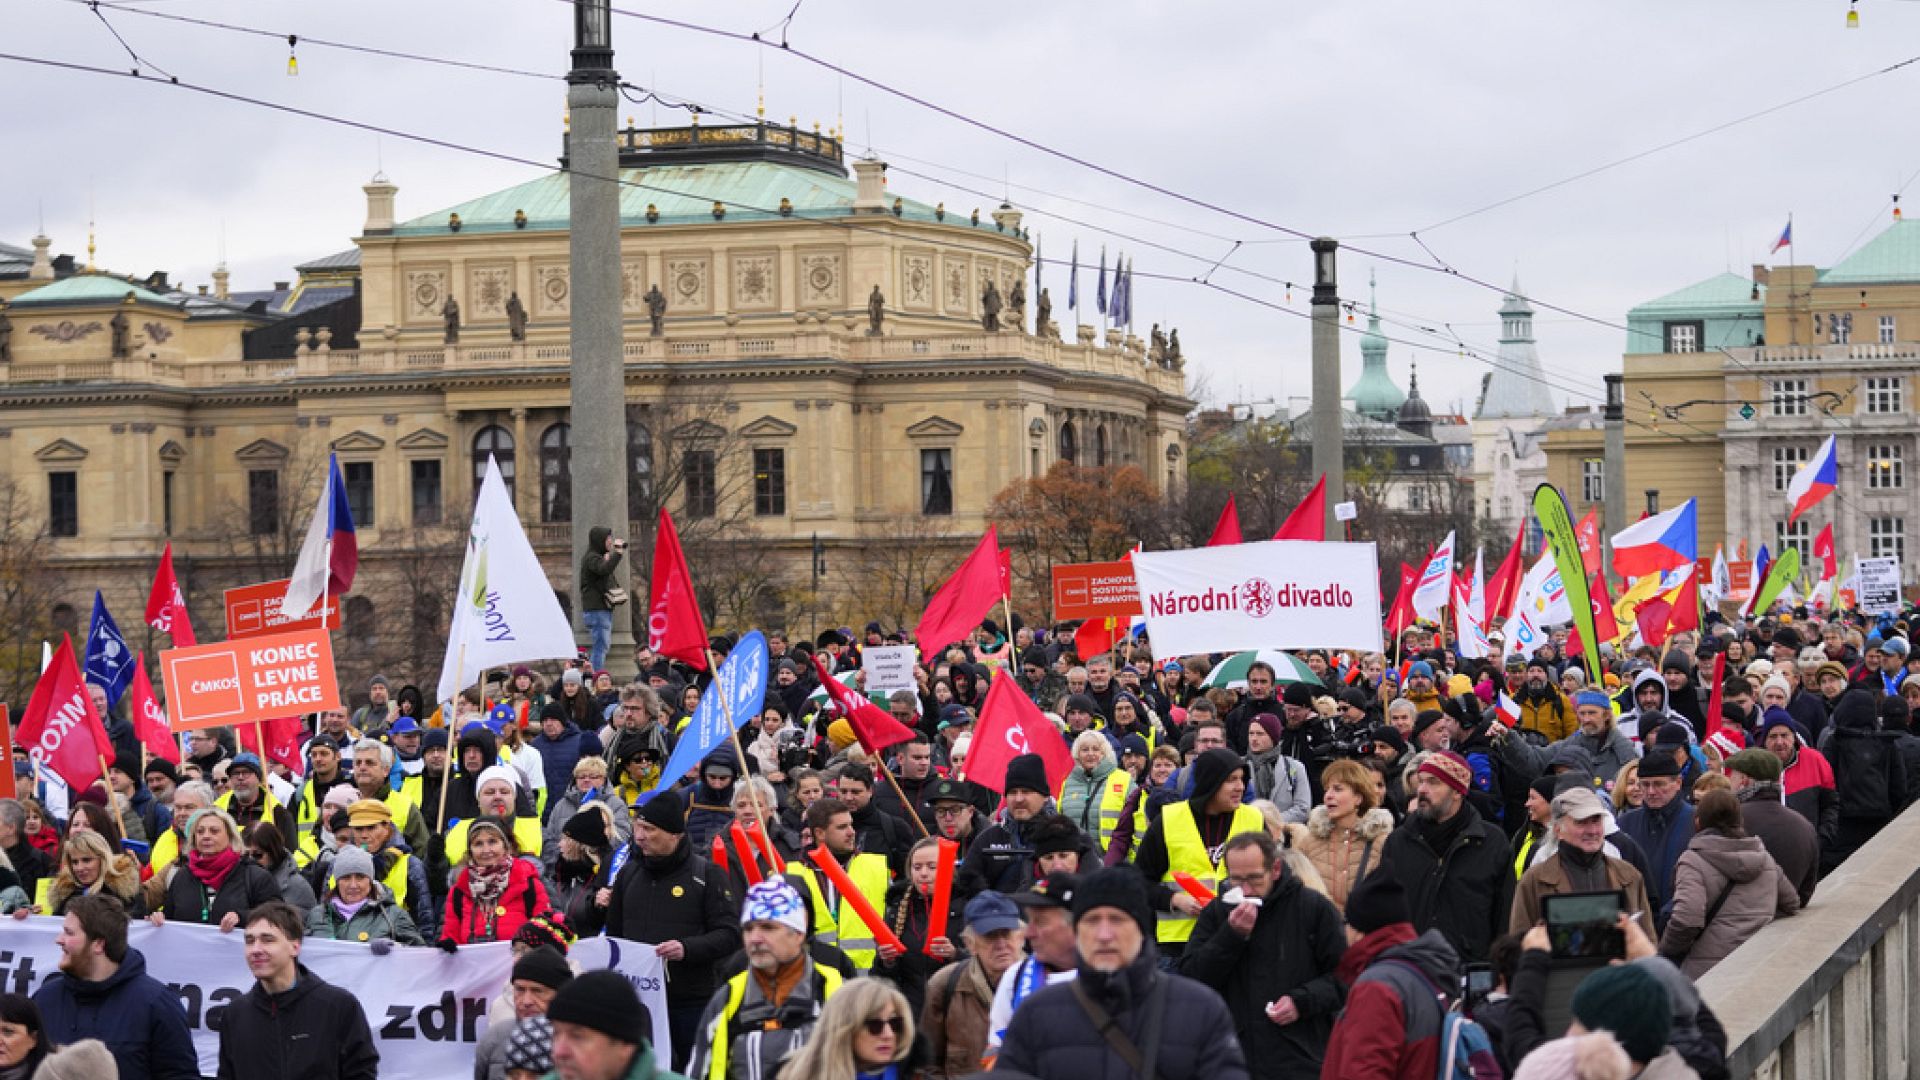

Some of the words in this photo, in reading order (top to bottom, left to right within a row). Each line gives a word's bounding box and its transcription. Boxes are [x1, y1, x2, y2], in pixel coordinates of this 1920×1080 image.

[1150, 585, 1238, 617] Národní
[1278, 583, 1353, 608] divadlo
[250, 642, 319, 666] KONEC
[191, 677, 240, 694] ČMKOS
[254, 661, 319, 688] LEVNÉ
[256, 686, 323, 709] PRÁCE
[29, 685, 88, 766] MKOS
